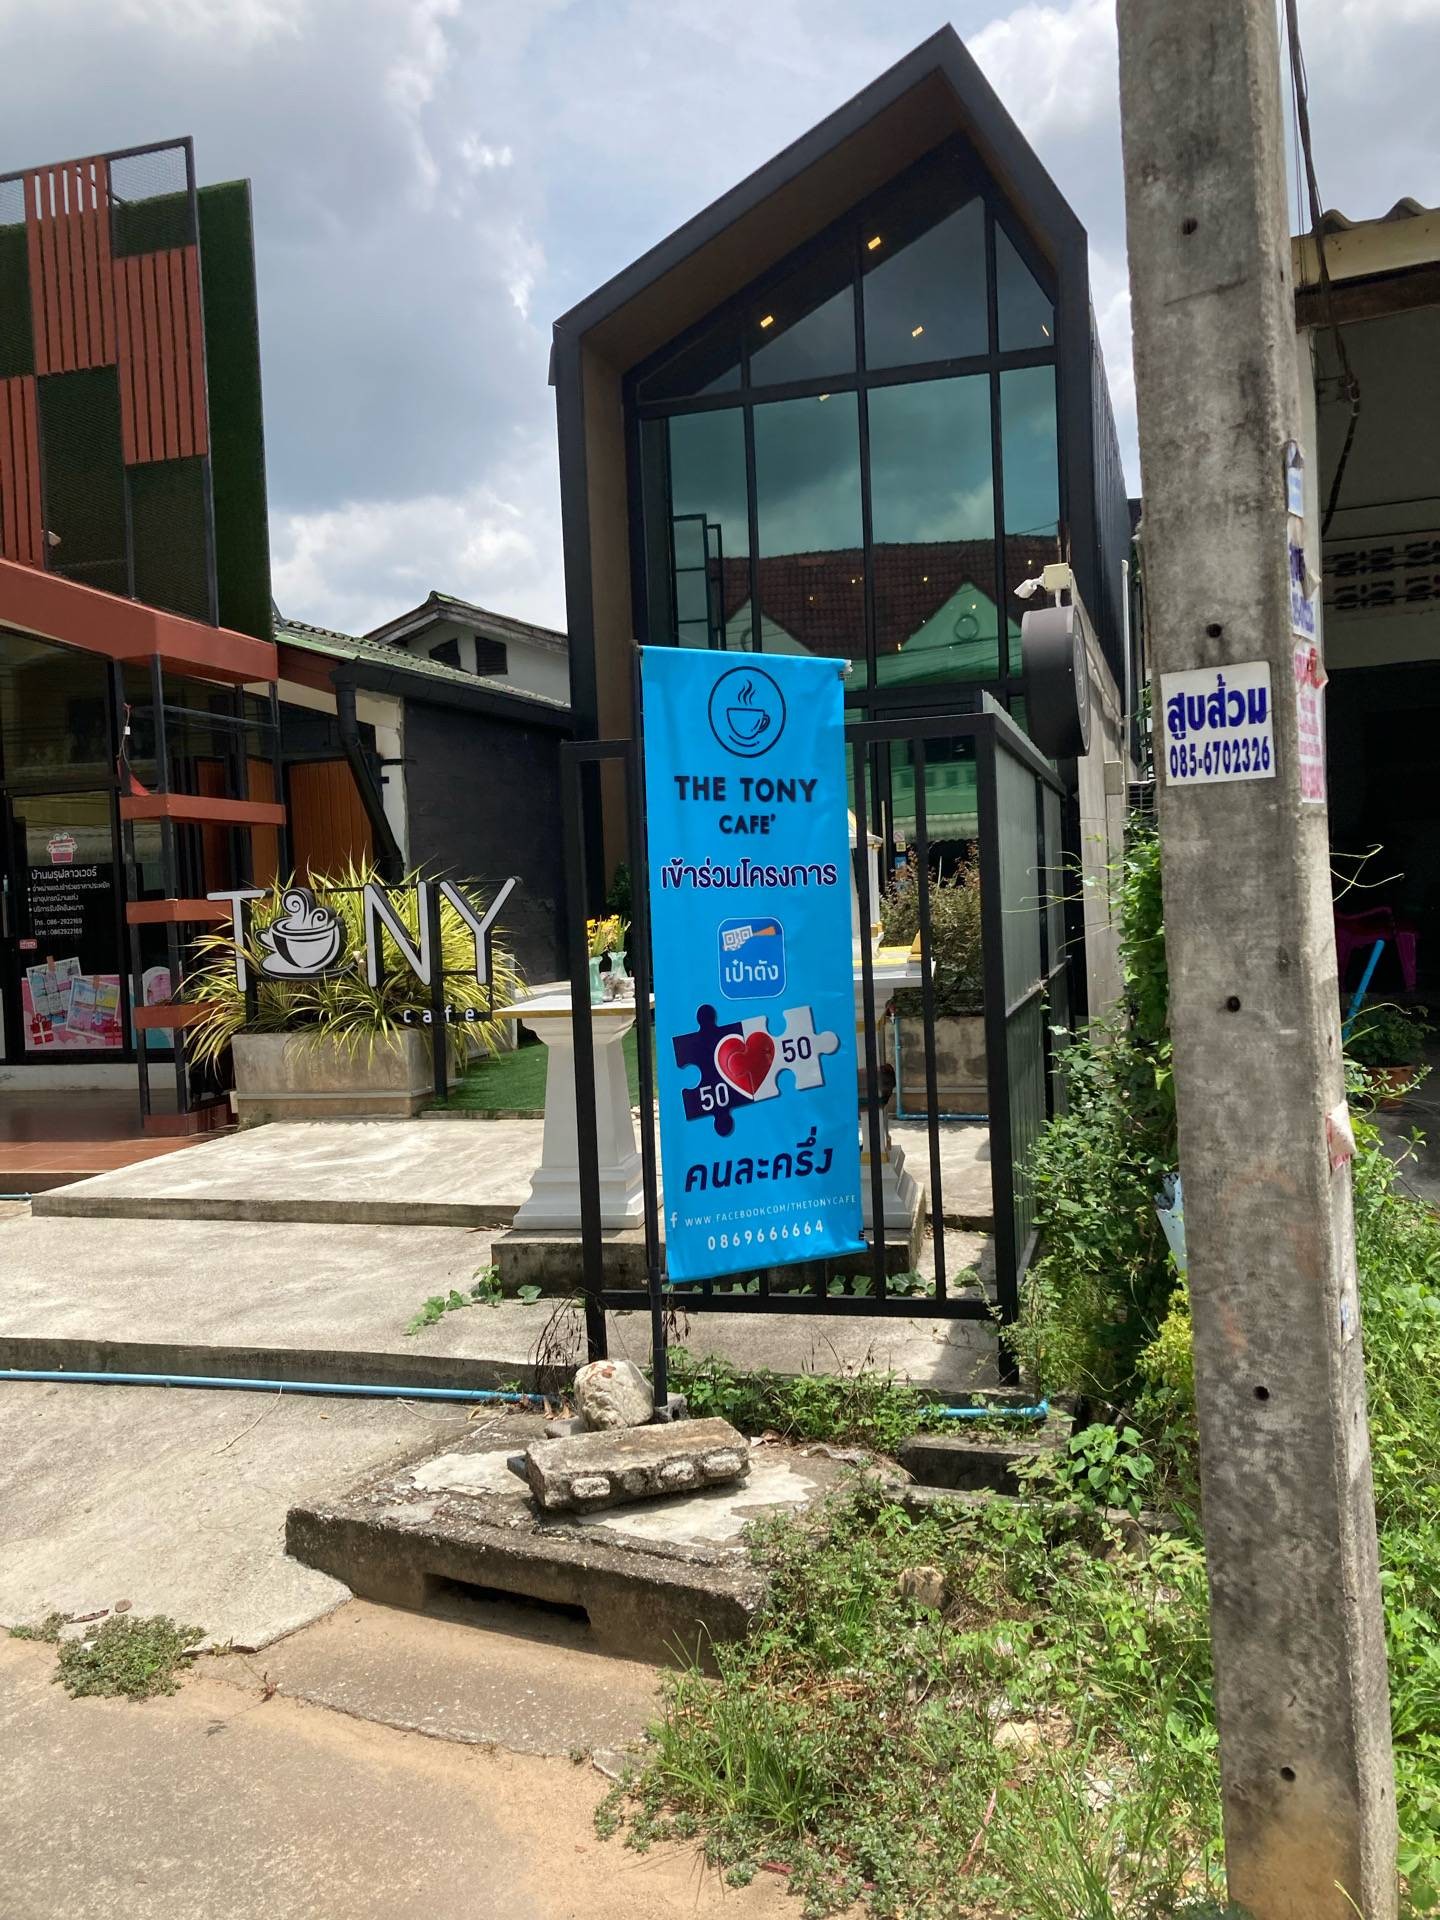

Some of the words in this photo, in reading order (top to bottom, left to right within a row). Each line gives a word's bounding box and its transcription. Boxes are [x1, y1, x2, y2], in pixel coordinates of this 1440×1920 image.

[1170, 735, 1270, 778] 085-6702326
[674, 775, 726, 801] THE
[740, 778, 818, 802] TONY
[661, 857, 837, 889] เข้าร่วมโครงการ
[725, 958, 779, 983] เป๋าตัง
[782, 1036, 812, 1063] 50
[700, 1082, 730, 1111] 50
[684, 1126, 834, 1193] คนละครึ่ง
[707, 1219, 824, 1250] 0869666664
